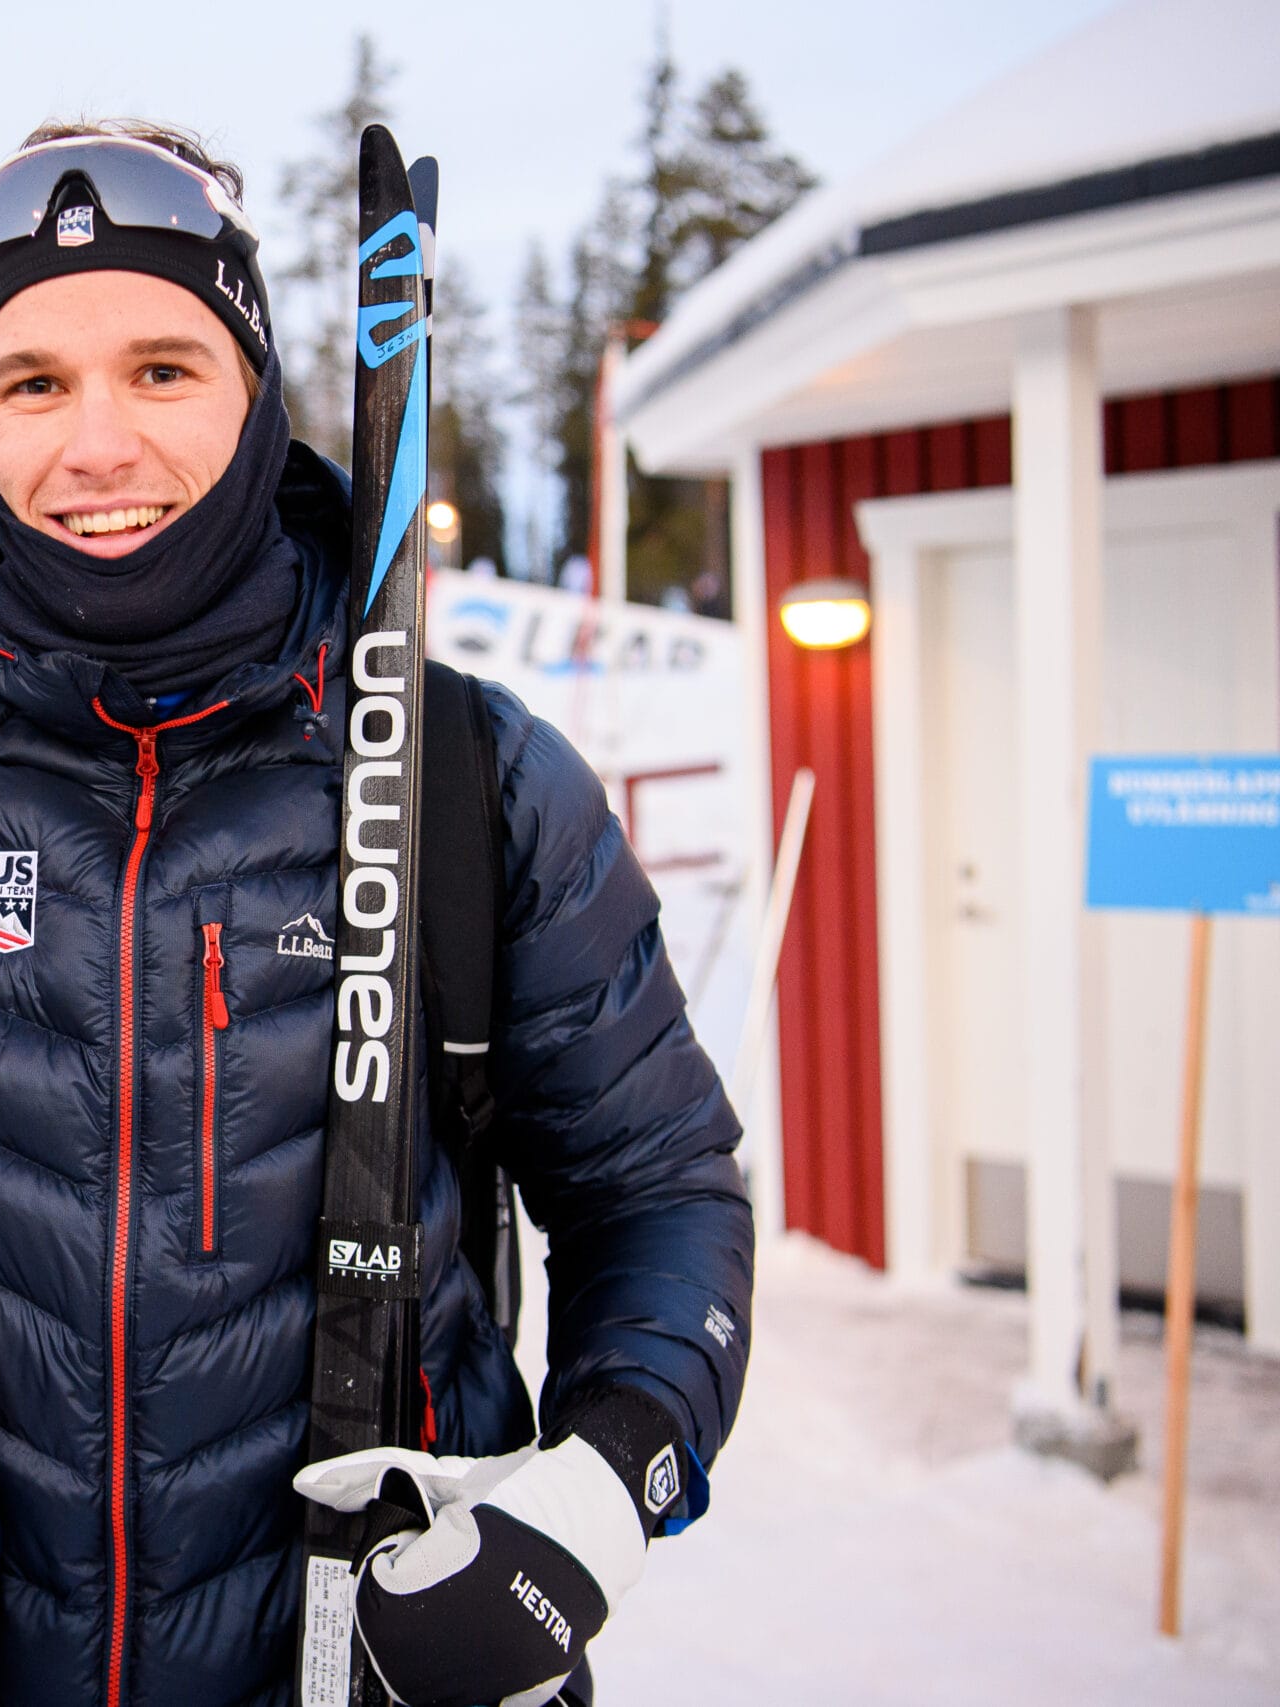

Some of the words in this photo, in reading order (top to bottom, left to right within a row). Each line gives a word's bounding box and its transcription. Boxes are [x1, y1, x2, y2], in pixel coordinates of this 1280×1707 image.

[7, 886, 34, 896] TEAM
[333, 630, 407, 1104] salomon
[277, 934, 333, 960] L.L.Bean
[509, 1570, 573, 1654] HESTRA
